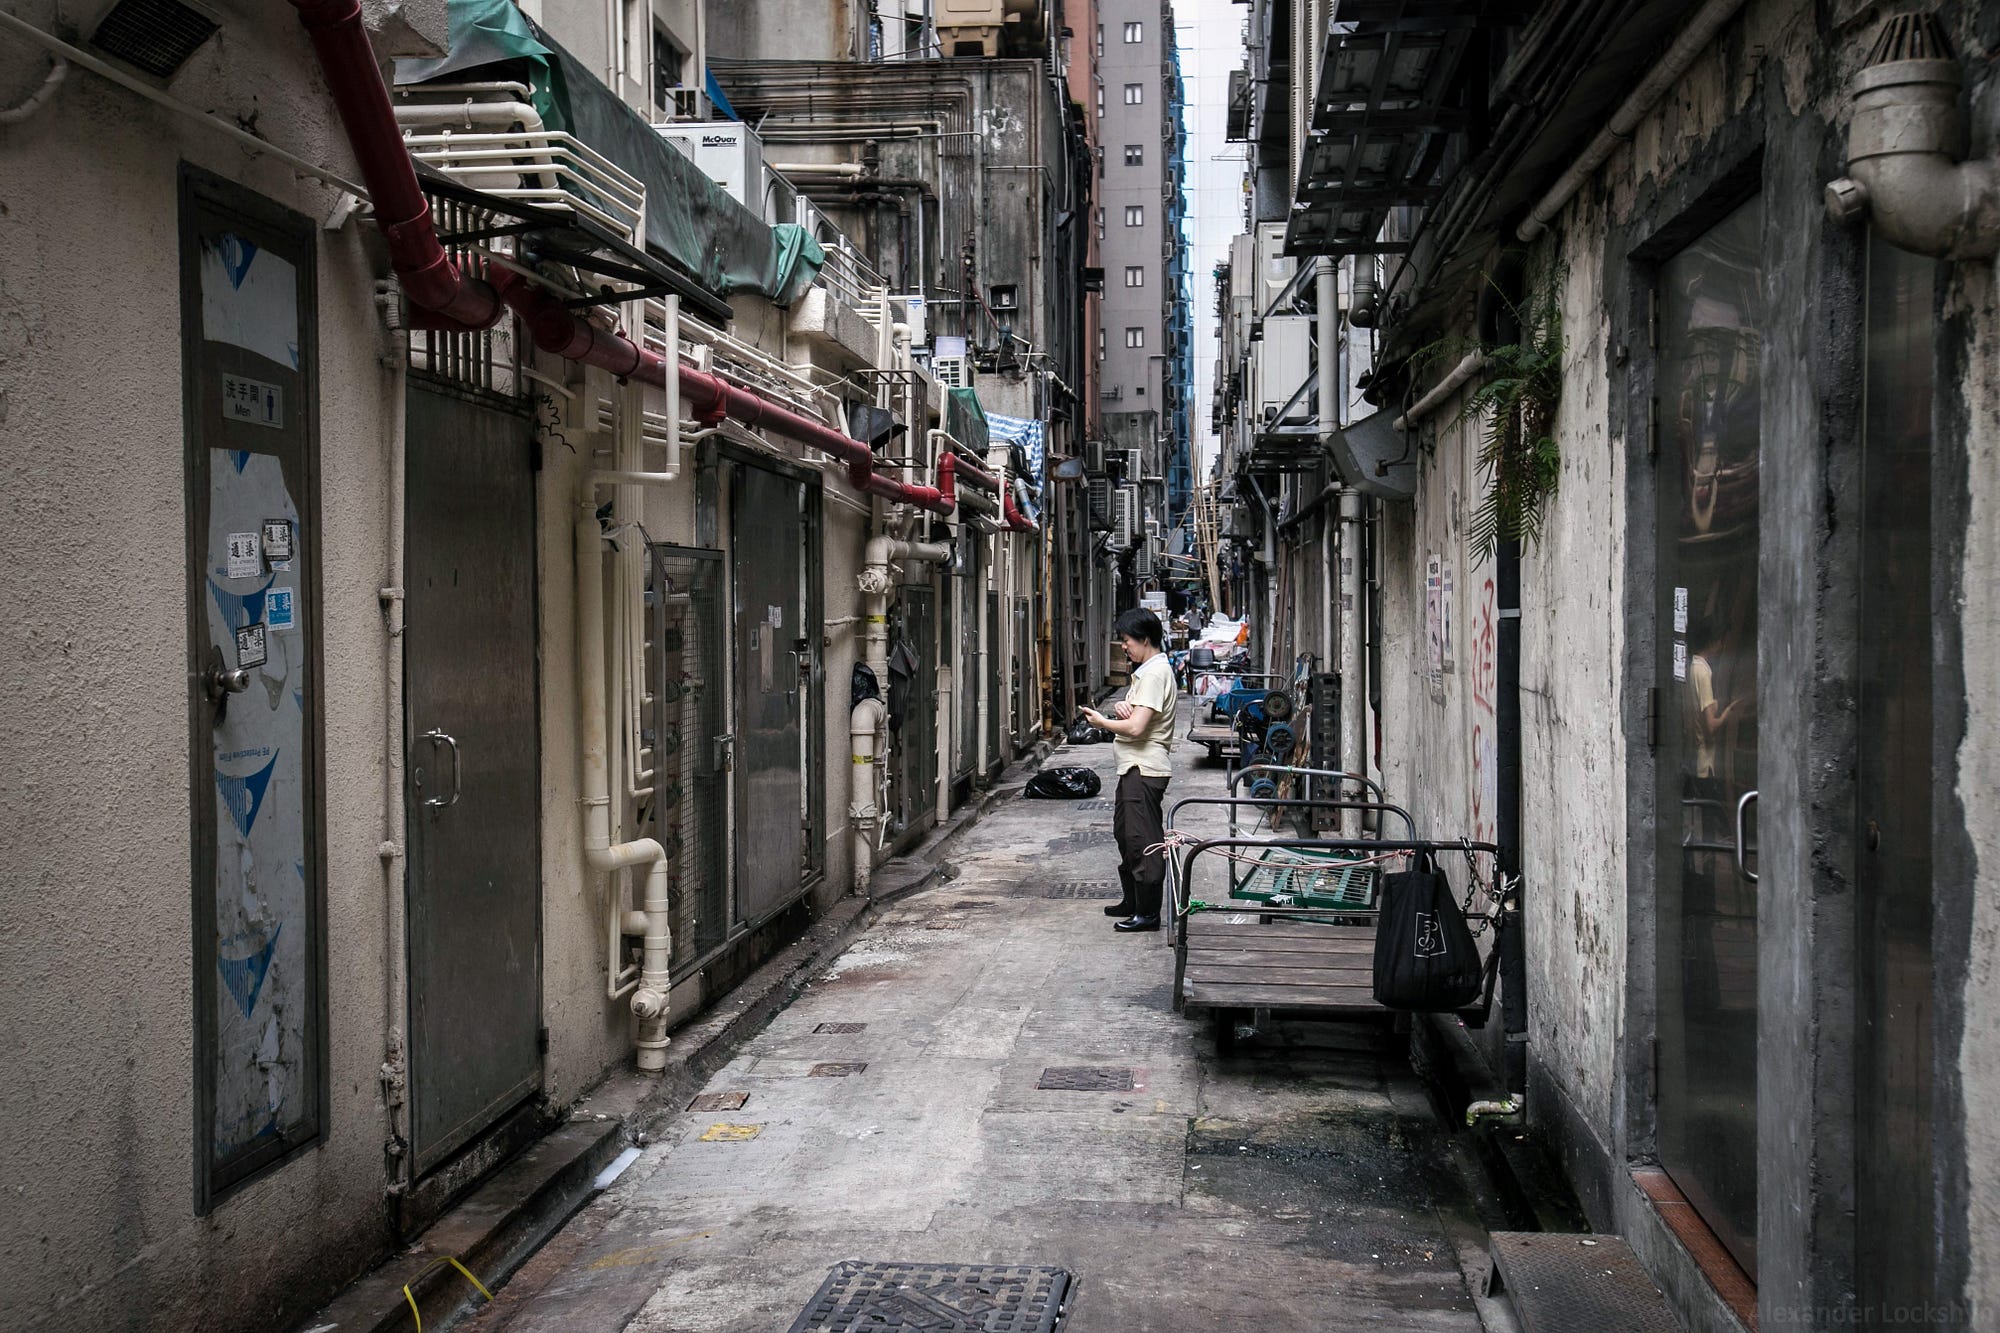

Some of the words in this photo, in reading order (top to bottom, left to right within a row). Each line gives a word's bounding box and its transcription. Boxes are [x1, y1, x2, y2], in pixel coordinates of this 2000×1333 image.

[702, 135, 737, 143] McQuay
[225, 379, 259, 403] 洗手間
[234, 403, 251, 417] Men
